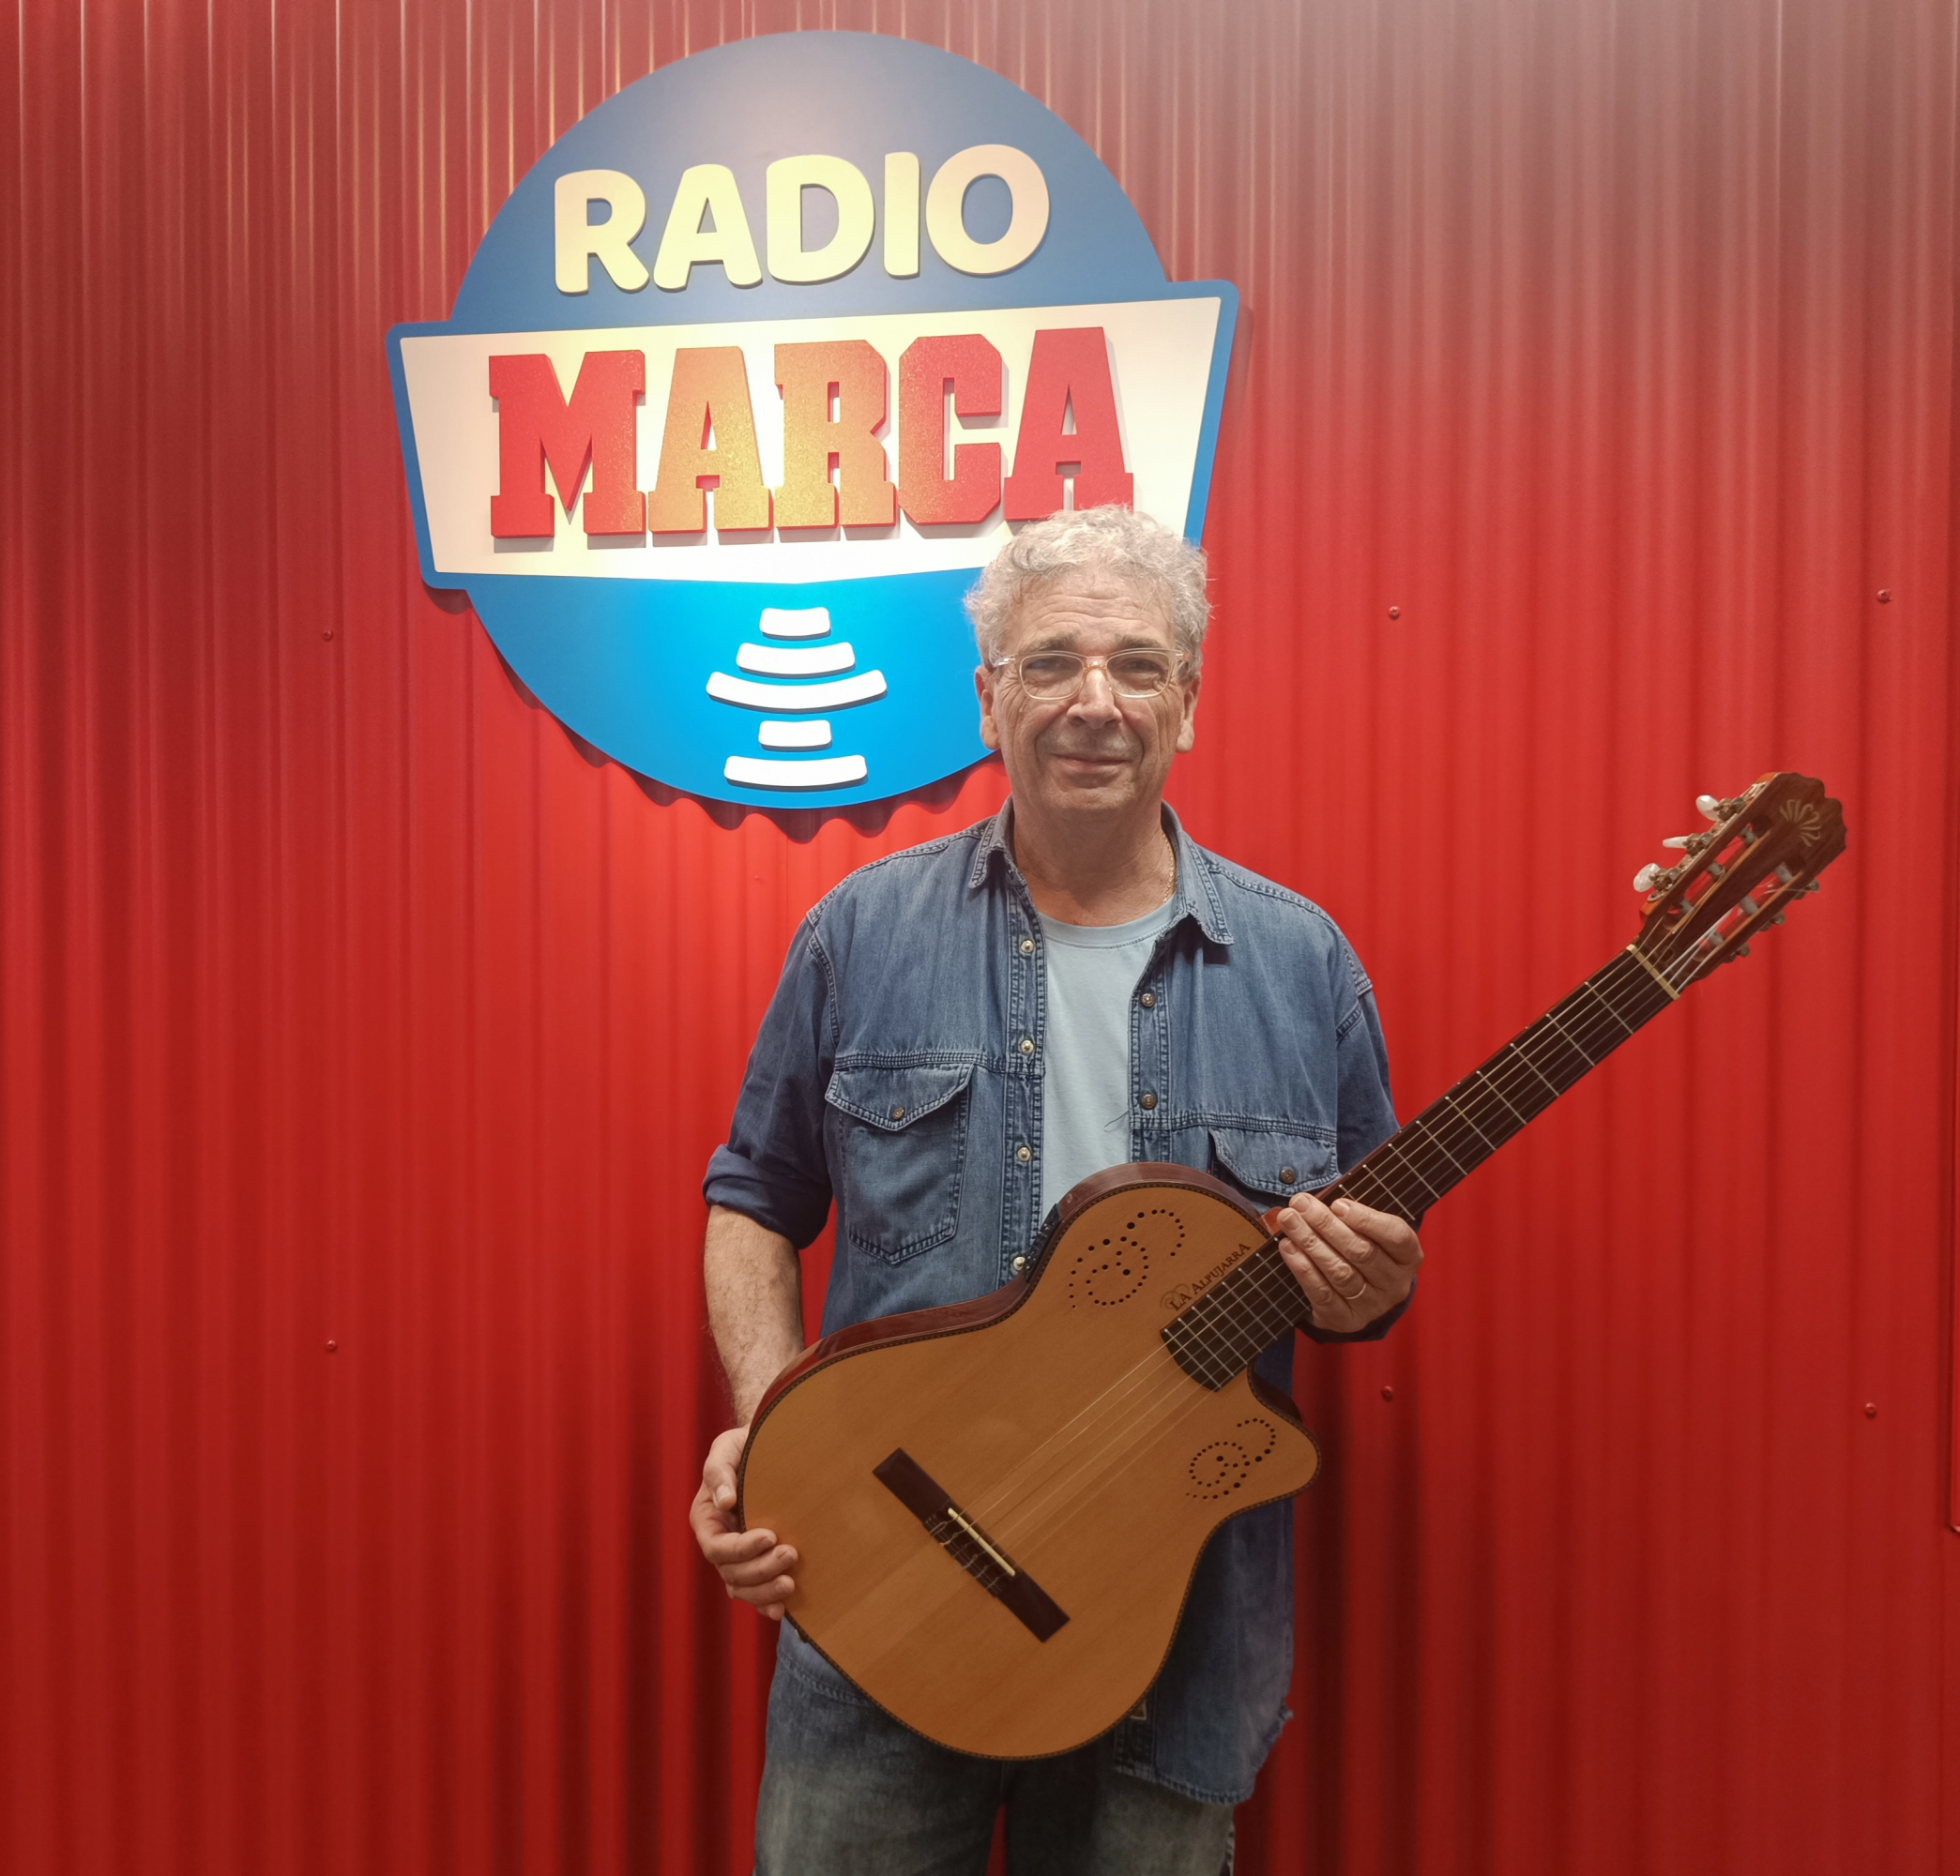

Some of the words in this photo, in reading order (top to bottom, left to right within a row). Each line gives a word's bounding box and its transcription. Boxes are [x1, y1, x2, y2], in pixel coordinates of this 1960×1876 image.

[554, 144, 1051, 295] RADIO
[488, 326, 1134, 539] MARCA
[1168, 1292, 1193, 1311] LA
[1191, 1243, 1252, 1295] ALPUJARRA
